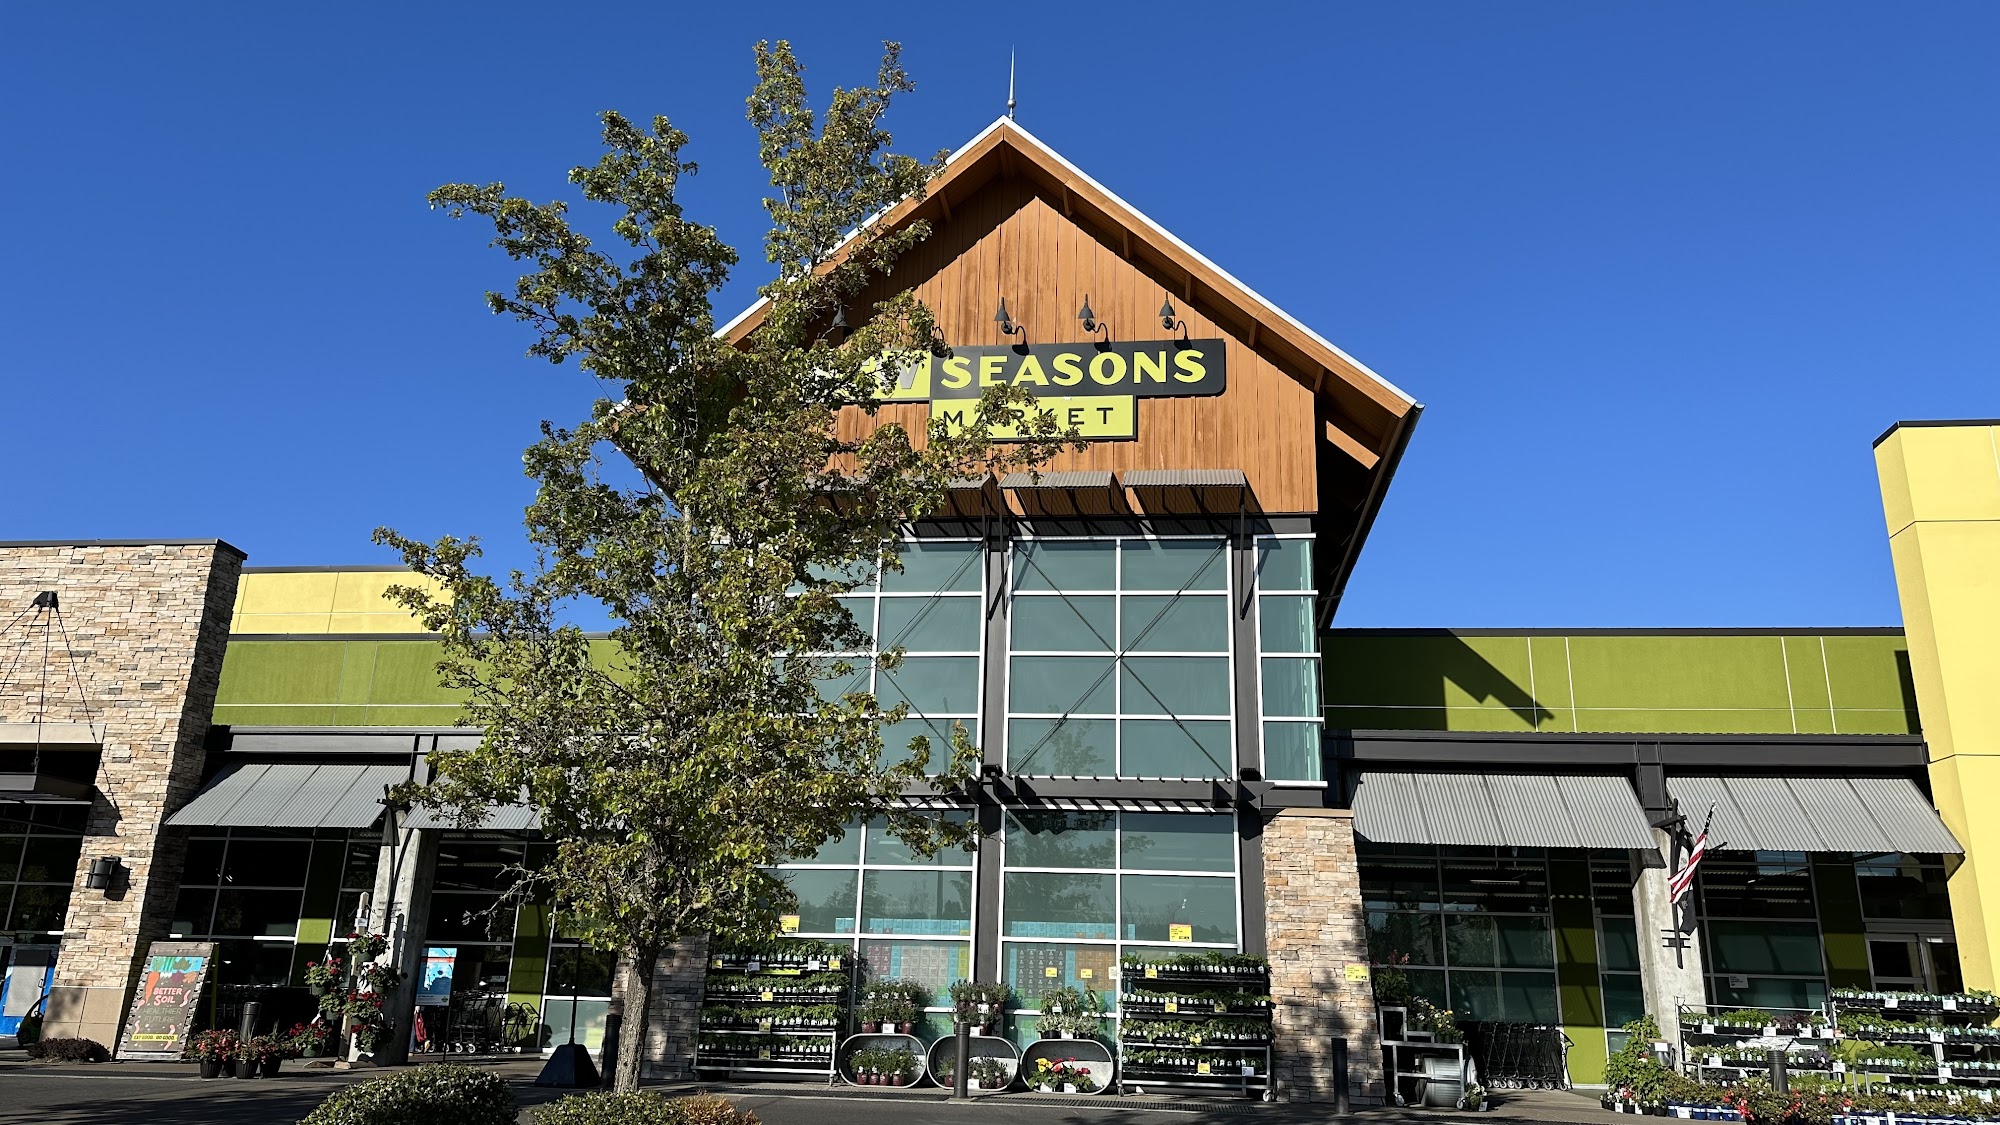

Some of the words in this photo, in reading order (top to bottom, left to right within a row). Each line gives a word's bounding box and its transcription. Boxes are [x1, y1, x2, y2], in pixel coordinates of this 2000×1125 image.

[941, 349, 1207, 390] SEASONS
[153, 987, 183, 995] BETTER
[153, 995, 176, 1006] SOIL
[143, 1007, 183, 1015] HEALTHIER
[144, 1015, 175, 1023] FUTURE
